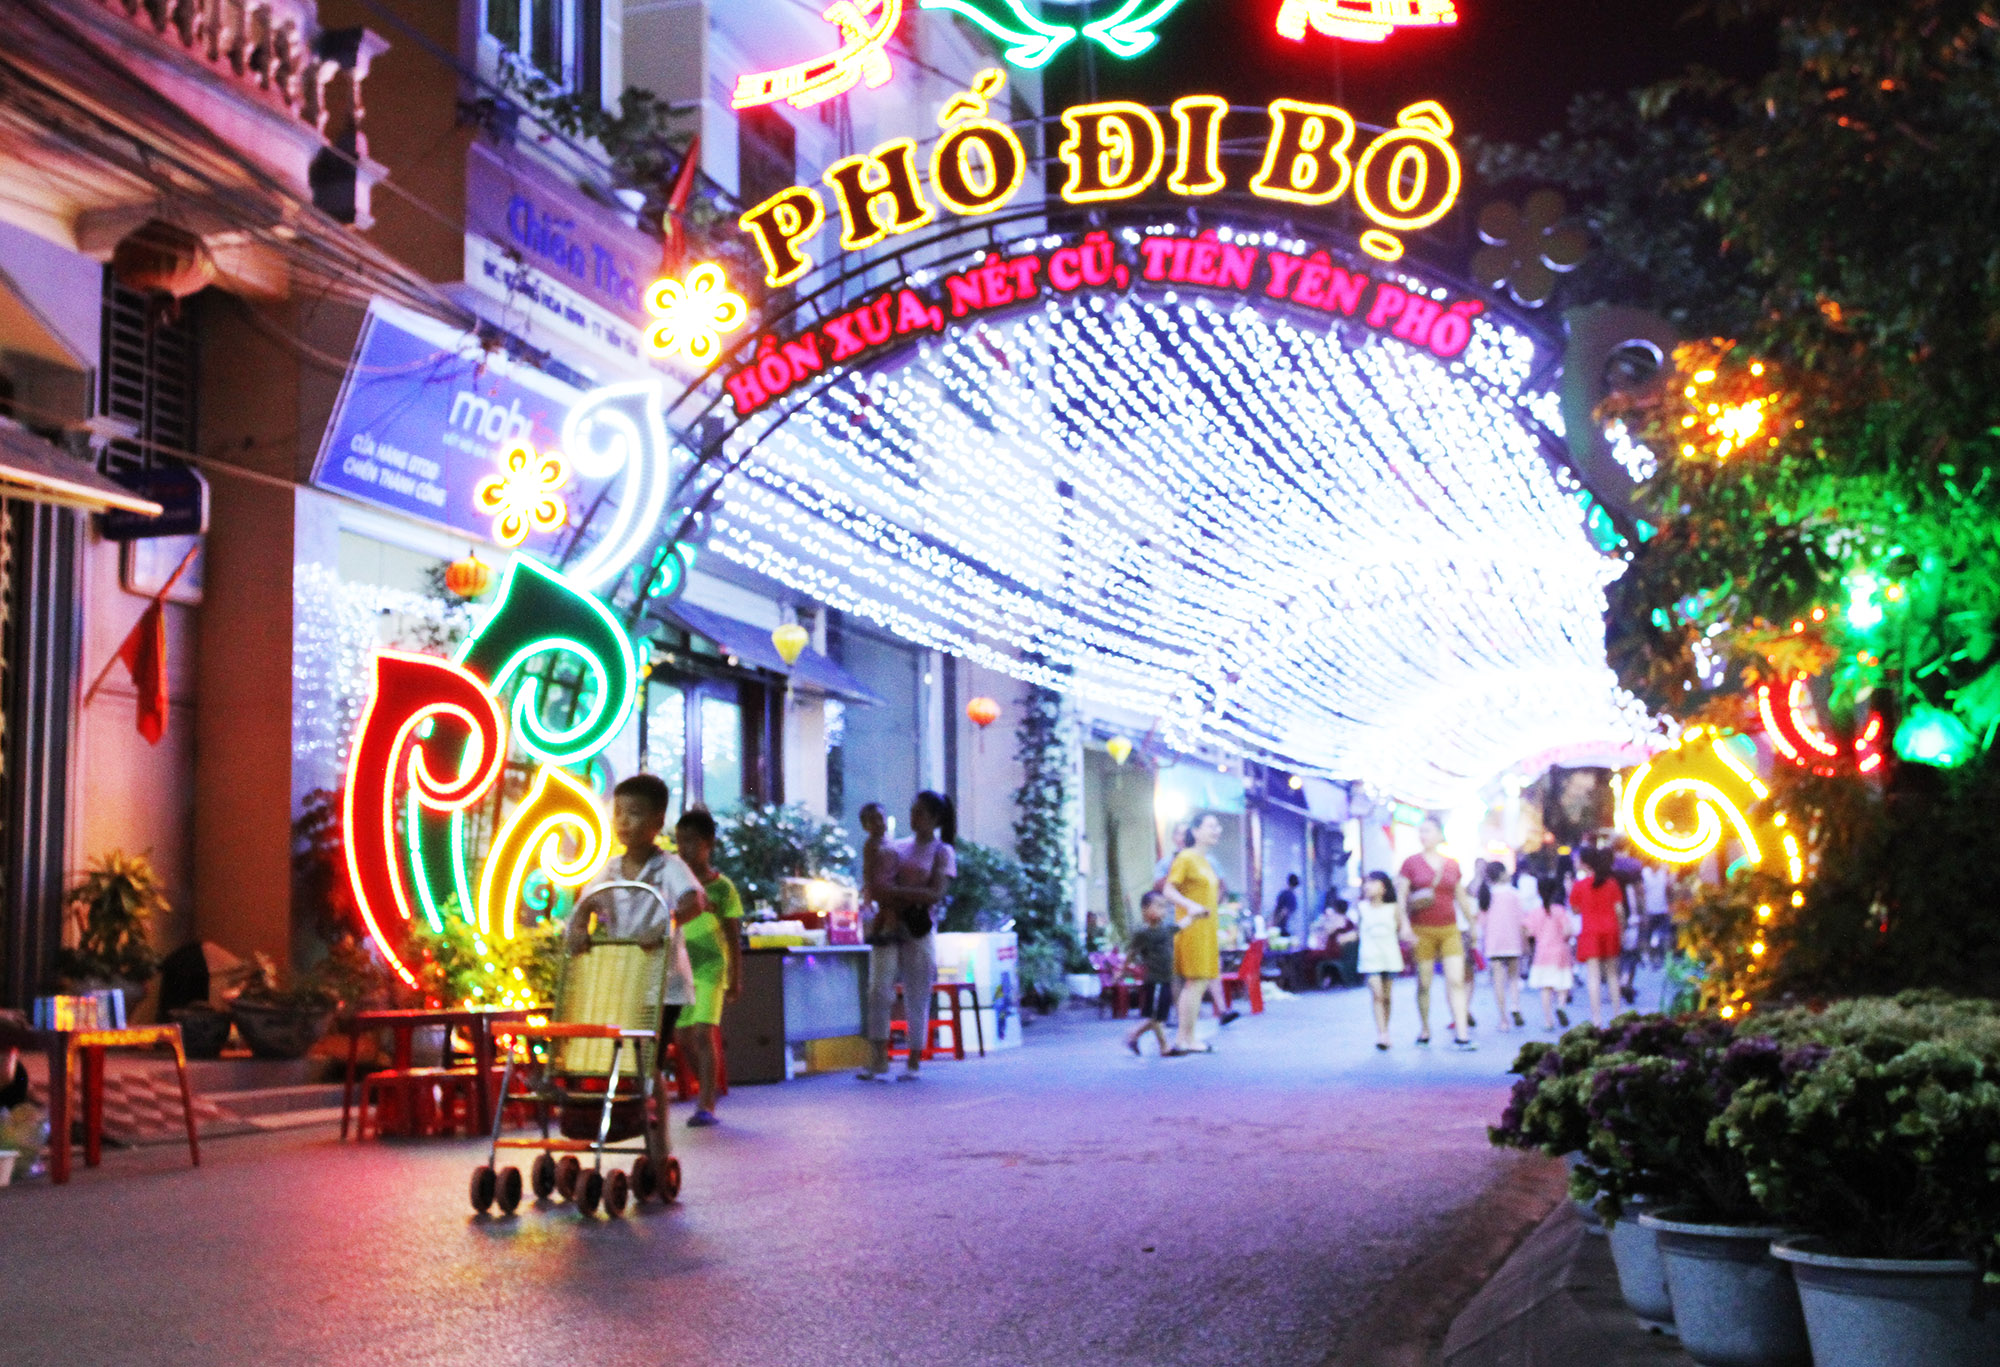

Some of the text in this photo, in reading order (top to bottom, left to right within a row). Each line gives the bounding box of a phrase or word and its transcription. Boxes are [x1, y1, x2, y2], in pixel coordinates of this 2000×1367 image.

[740, 67, 1461, 287] PHỐ ĐI BỘ
[823, 289, 943, 361] XƯA,
[945, 253, 1041, 317] NÉT
[1048, 231, 1130, 291] CŨ,
[1141, 229, 1258, 289] TIÊN
[1266, 251, 1369, 316] YÊN
[1366, 283, 1484, 357] PHỐ
